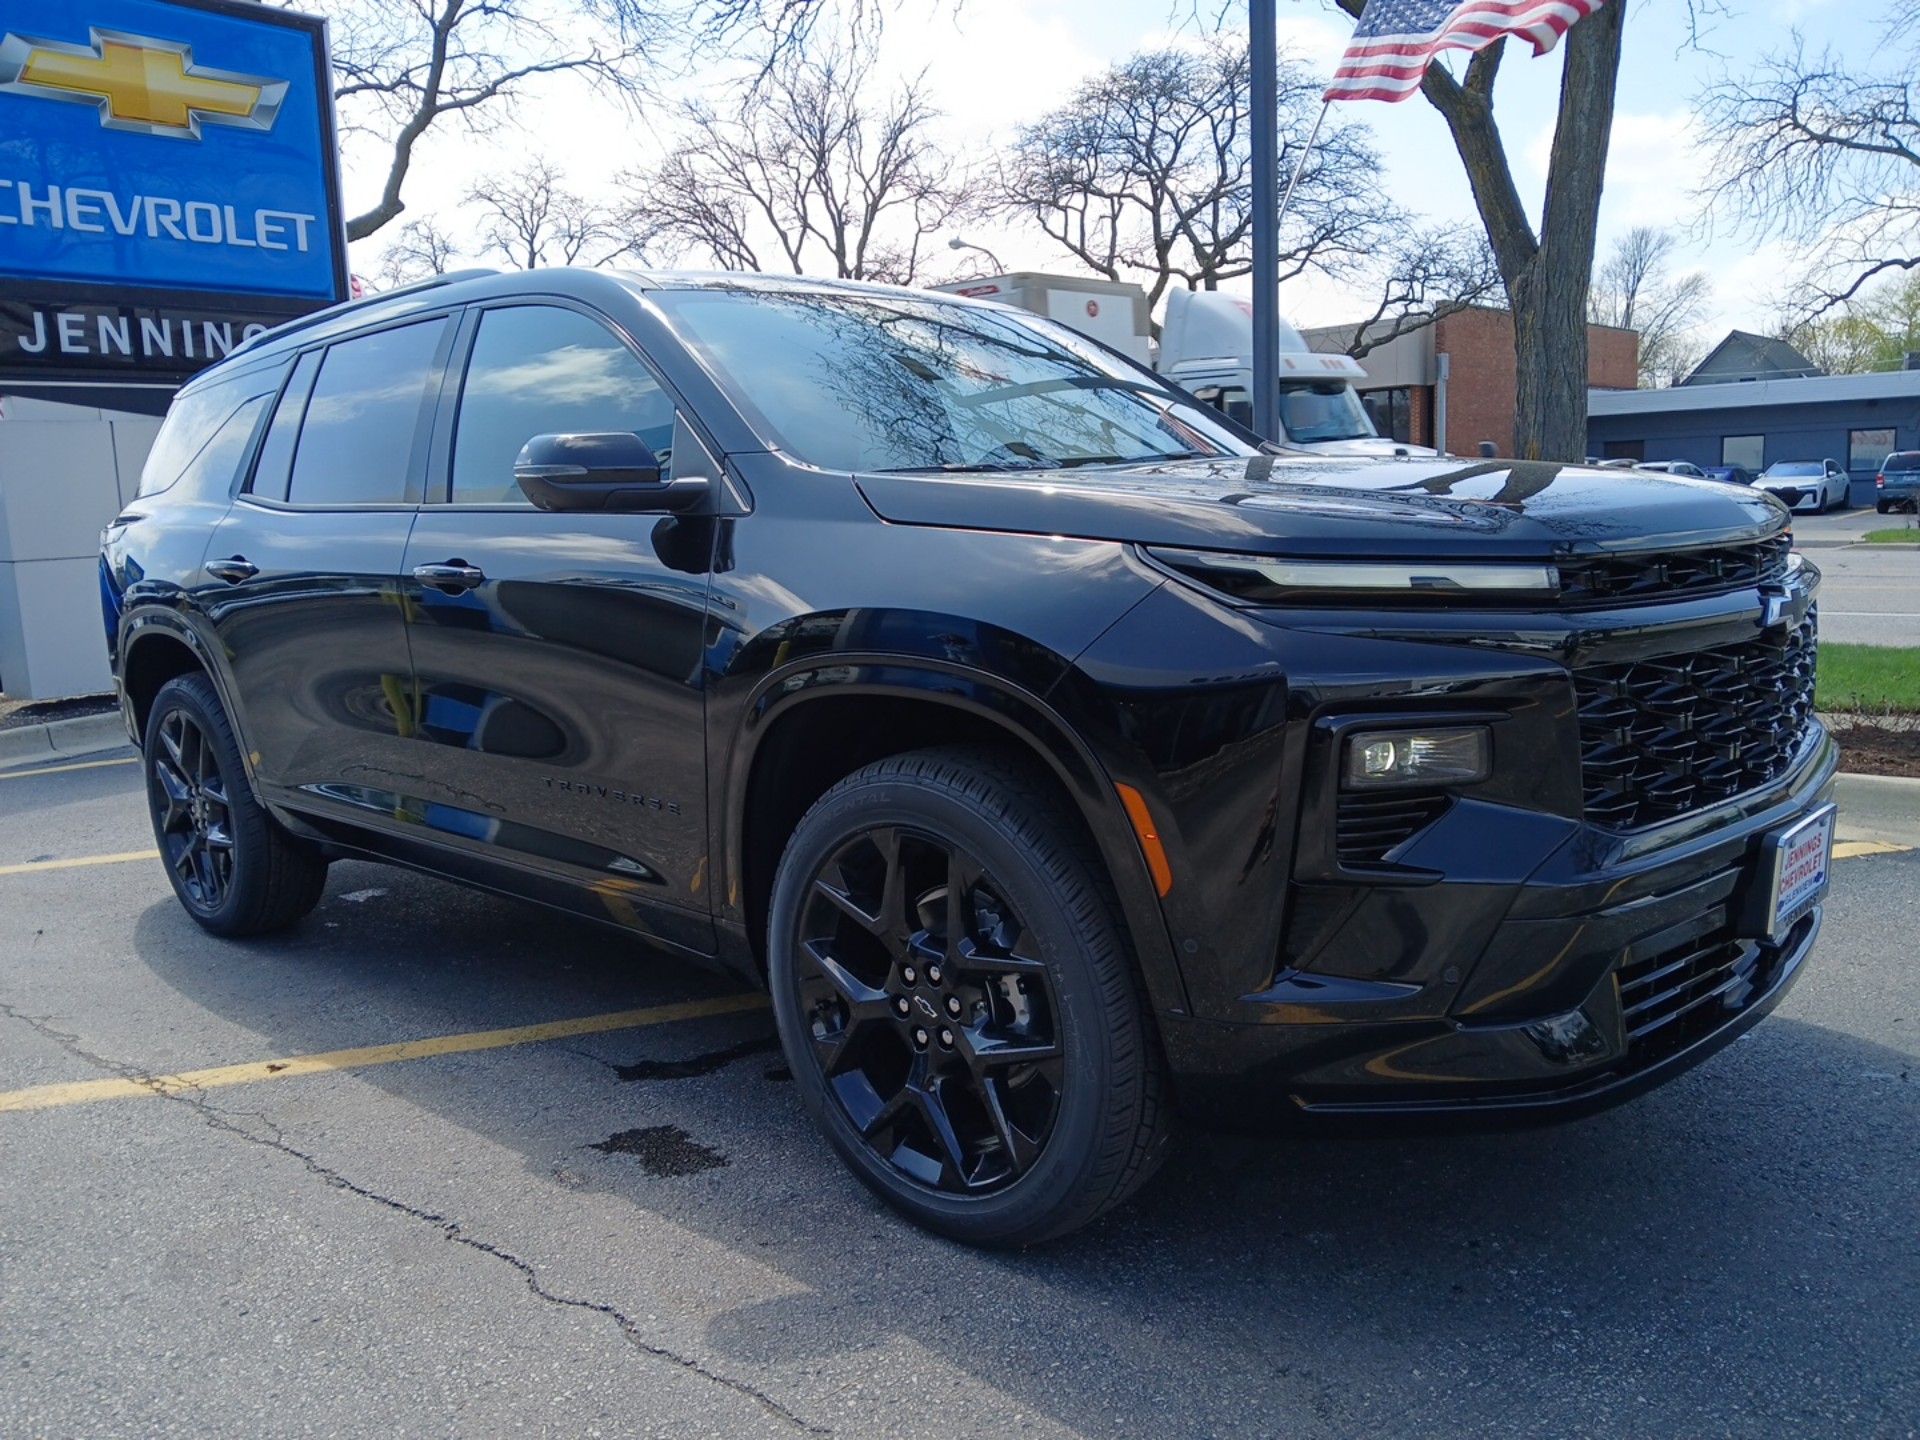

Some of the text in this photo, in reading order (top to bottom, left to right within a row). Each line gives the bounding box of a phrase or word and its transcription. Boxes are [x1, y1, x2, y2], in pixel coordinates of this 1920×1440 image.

[18, 311, 273, 358] JENNIN
[541, 776, 681, 815] TRAVERSE
[1784, 832, 1822, 871] JENNINGS
[1779, 851, 1824, 896] CHEVROLET
